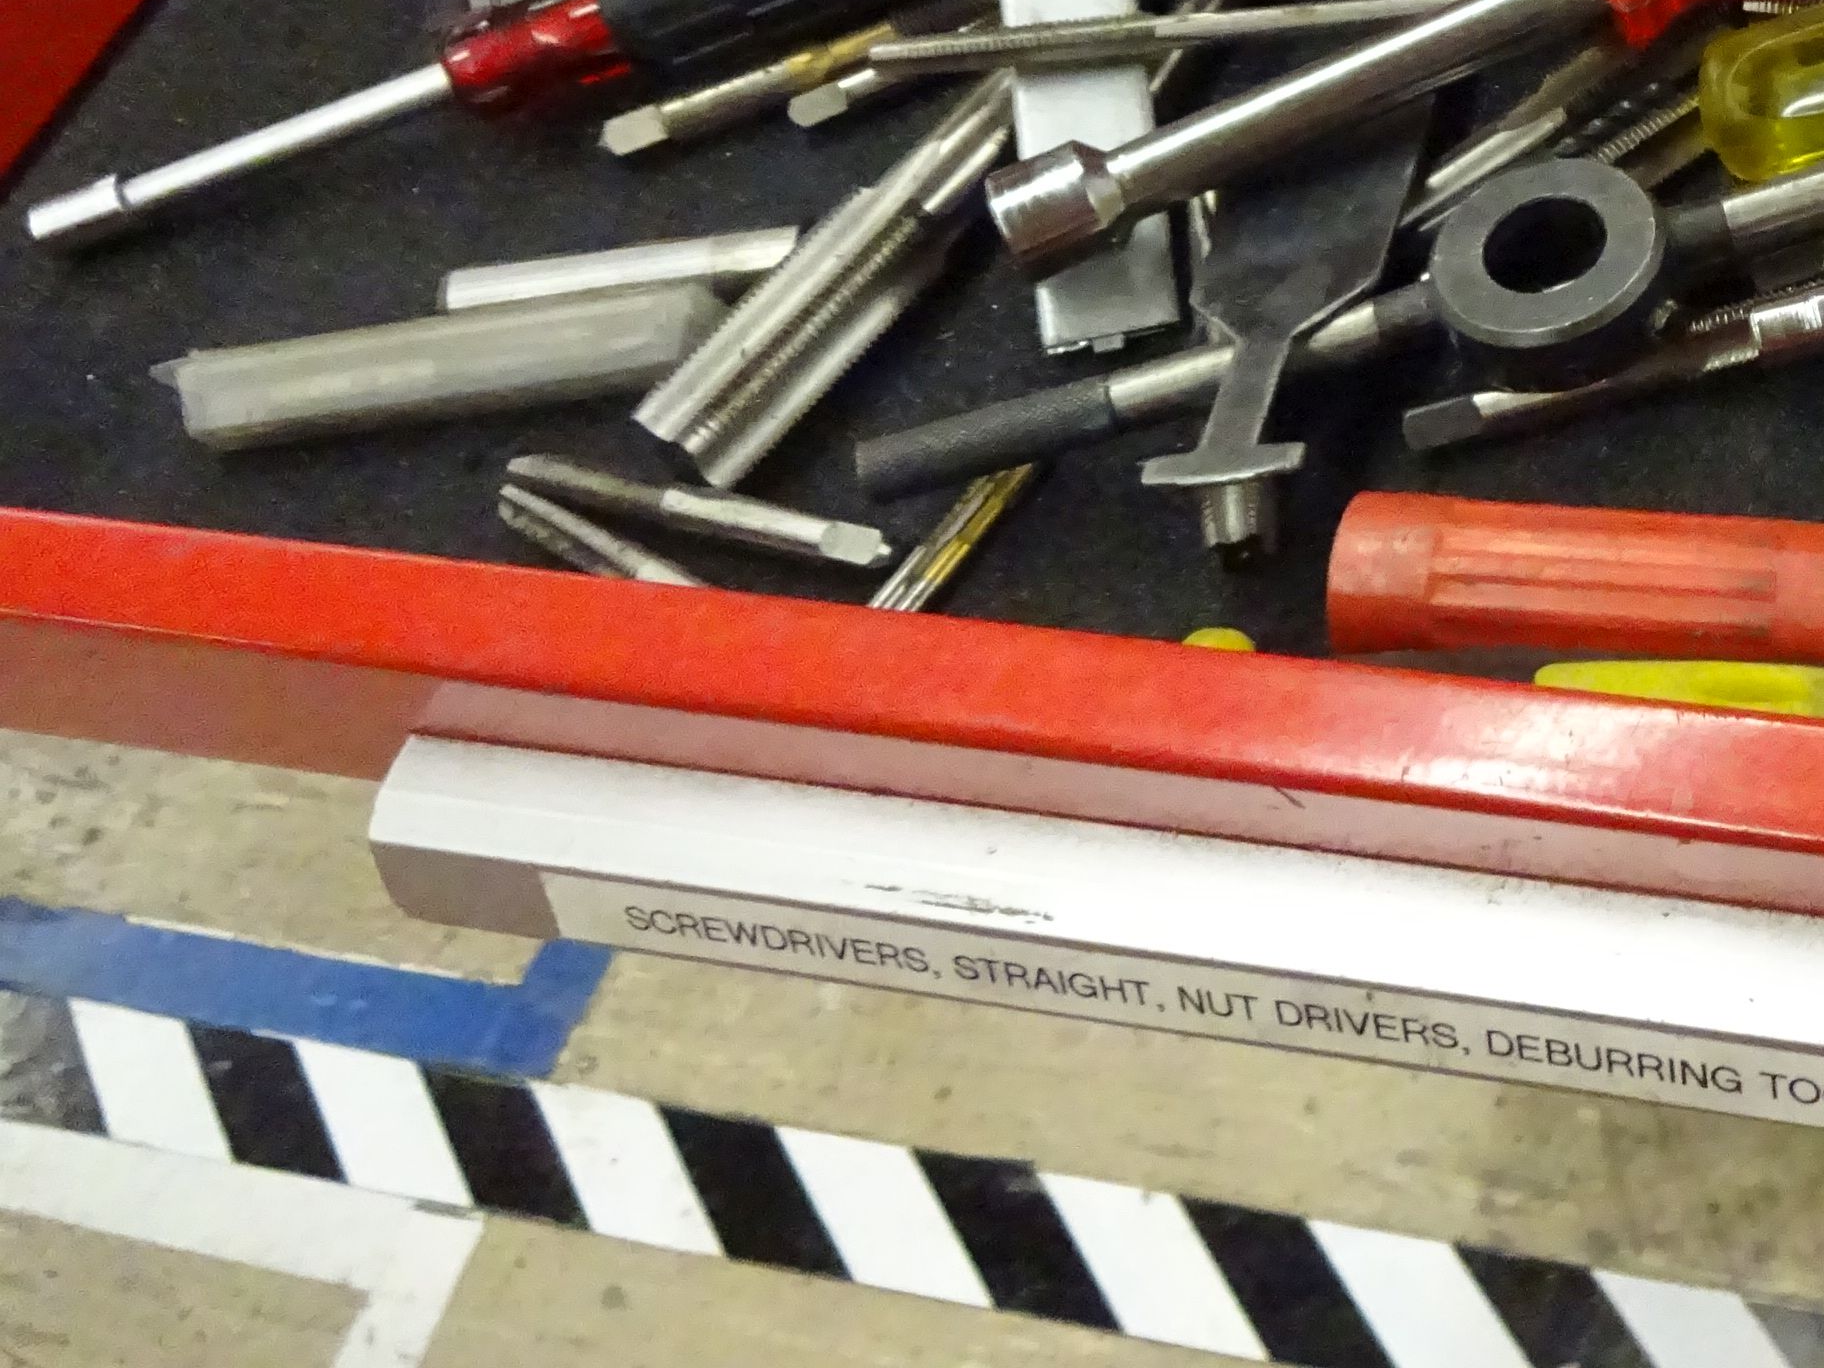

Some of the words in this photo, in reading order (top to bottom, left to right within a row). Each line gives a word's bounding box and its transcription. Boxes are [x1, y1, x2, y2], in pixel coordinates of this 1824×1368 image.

[625, 905, 942, 978] SCREWDRIVERS,
[953, 955, 1166, 1013] STRAIGHT,
[1178, 985, 1257, 1024] NUT
[1274, 999, 1470, 1056] DRIVERS,
[1486, 1030, 1742, 1095] DEBURRING
